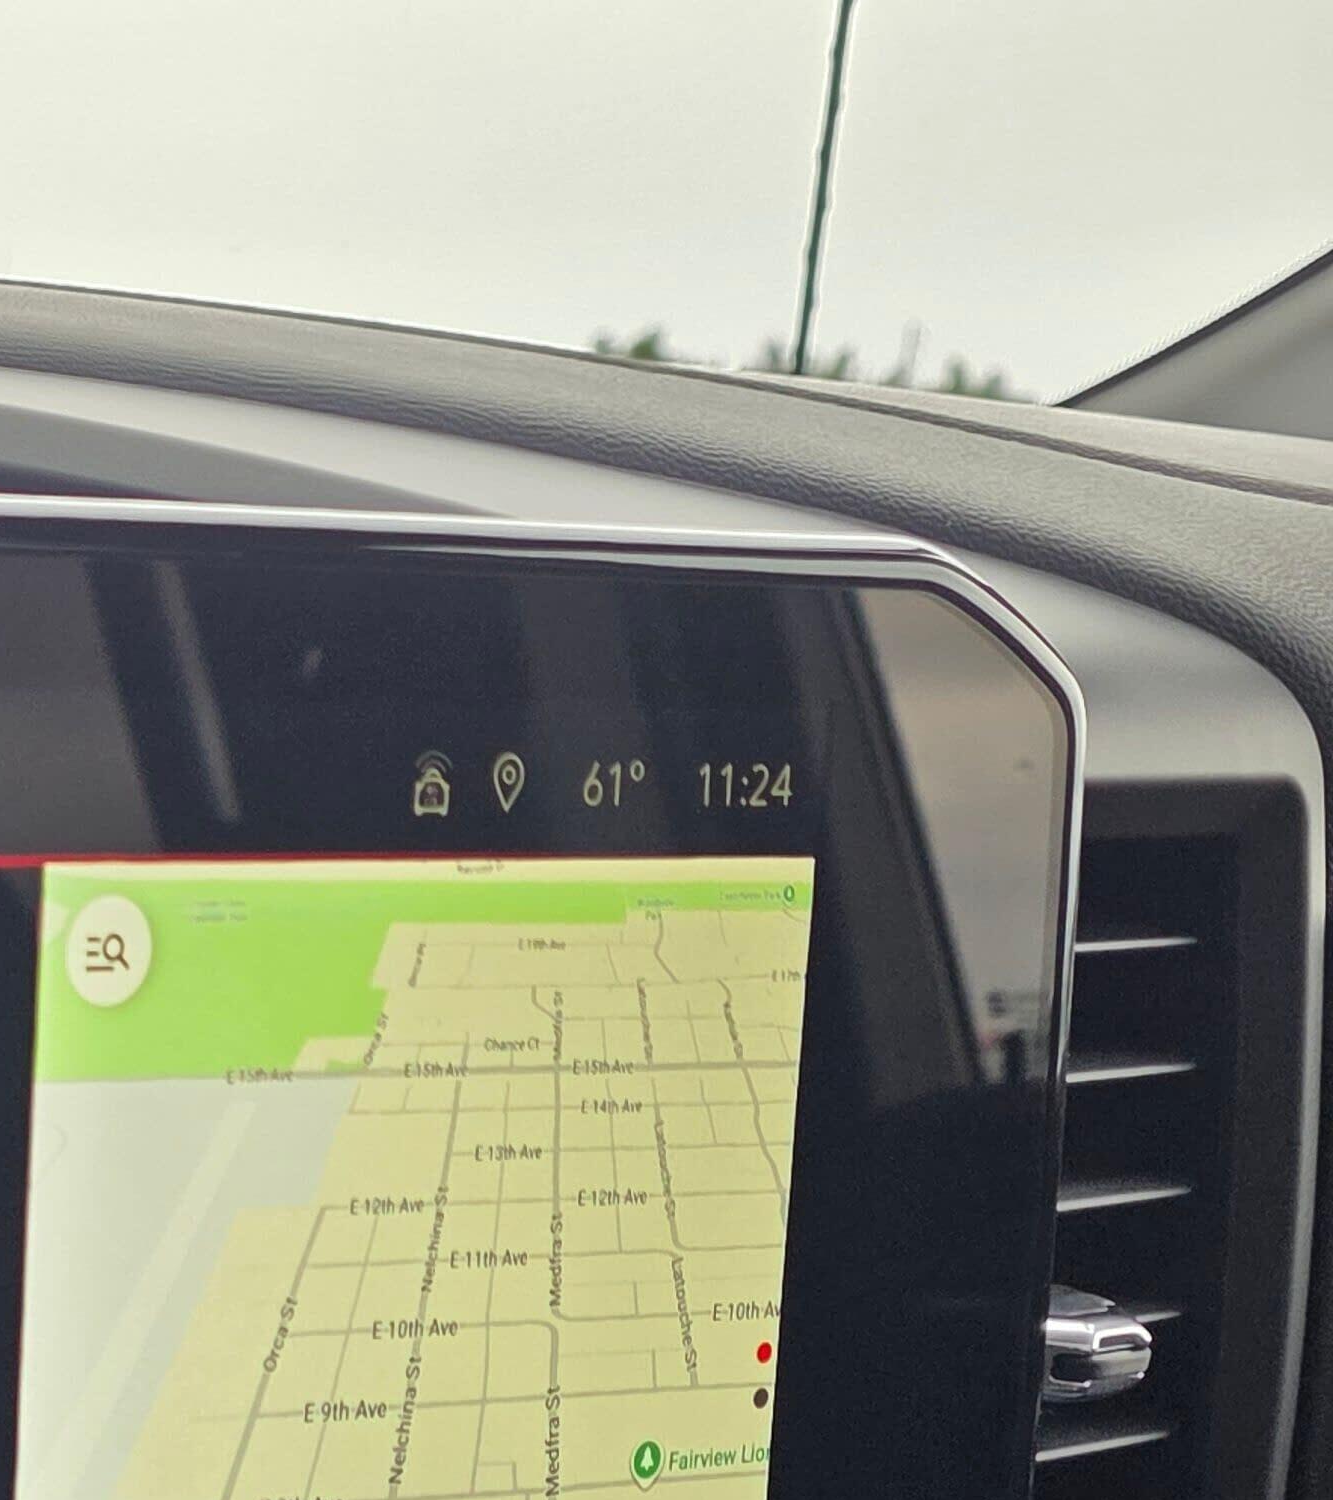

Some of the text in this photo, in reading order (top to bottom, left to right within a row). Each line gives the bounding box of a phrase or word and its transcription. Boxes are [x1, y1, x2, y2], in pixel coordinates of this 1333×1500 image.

[698, 761, 794, 808] 11:24
[611, 1058, 635, 1074] Ave
[621, 1098, 643, 1113] Ave
[475, 1143, 543, 1162] E 13th Ave
[350, 1197, 425, 1215] E 12th Ave
[577, 1187, 648, 1207] E 12th Ave
[449, 1248, 528, 1269] E 11th Ave
[548, 1211, 563, 1308] Medfra St
[712, 1302, 723, 1321] E
[727, 1300, 760, 1321] 10th
[263, 1295, 299, 1374] Orca St
[372, 1317, 459, 1340] E 10th Ave
[303, 1399, 388, 1424] E 9th Ave
[387, 1354, 422, 1485] Nelchina St
[545, 1384, 562, 1498] Medfra St
[668, 1447, 737, 1472] Fairview
